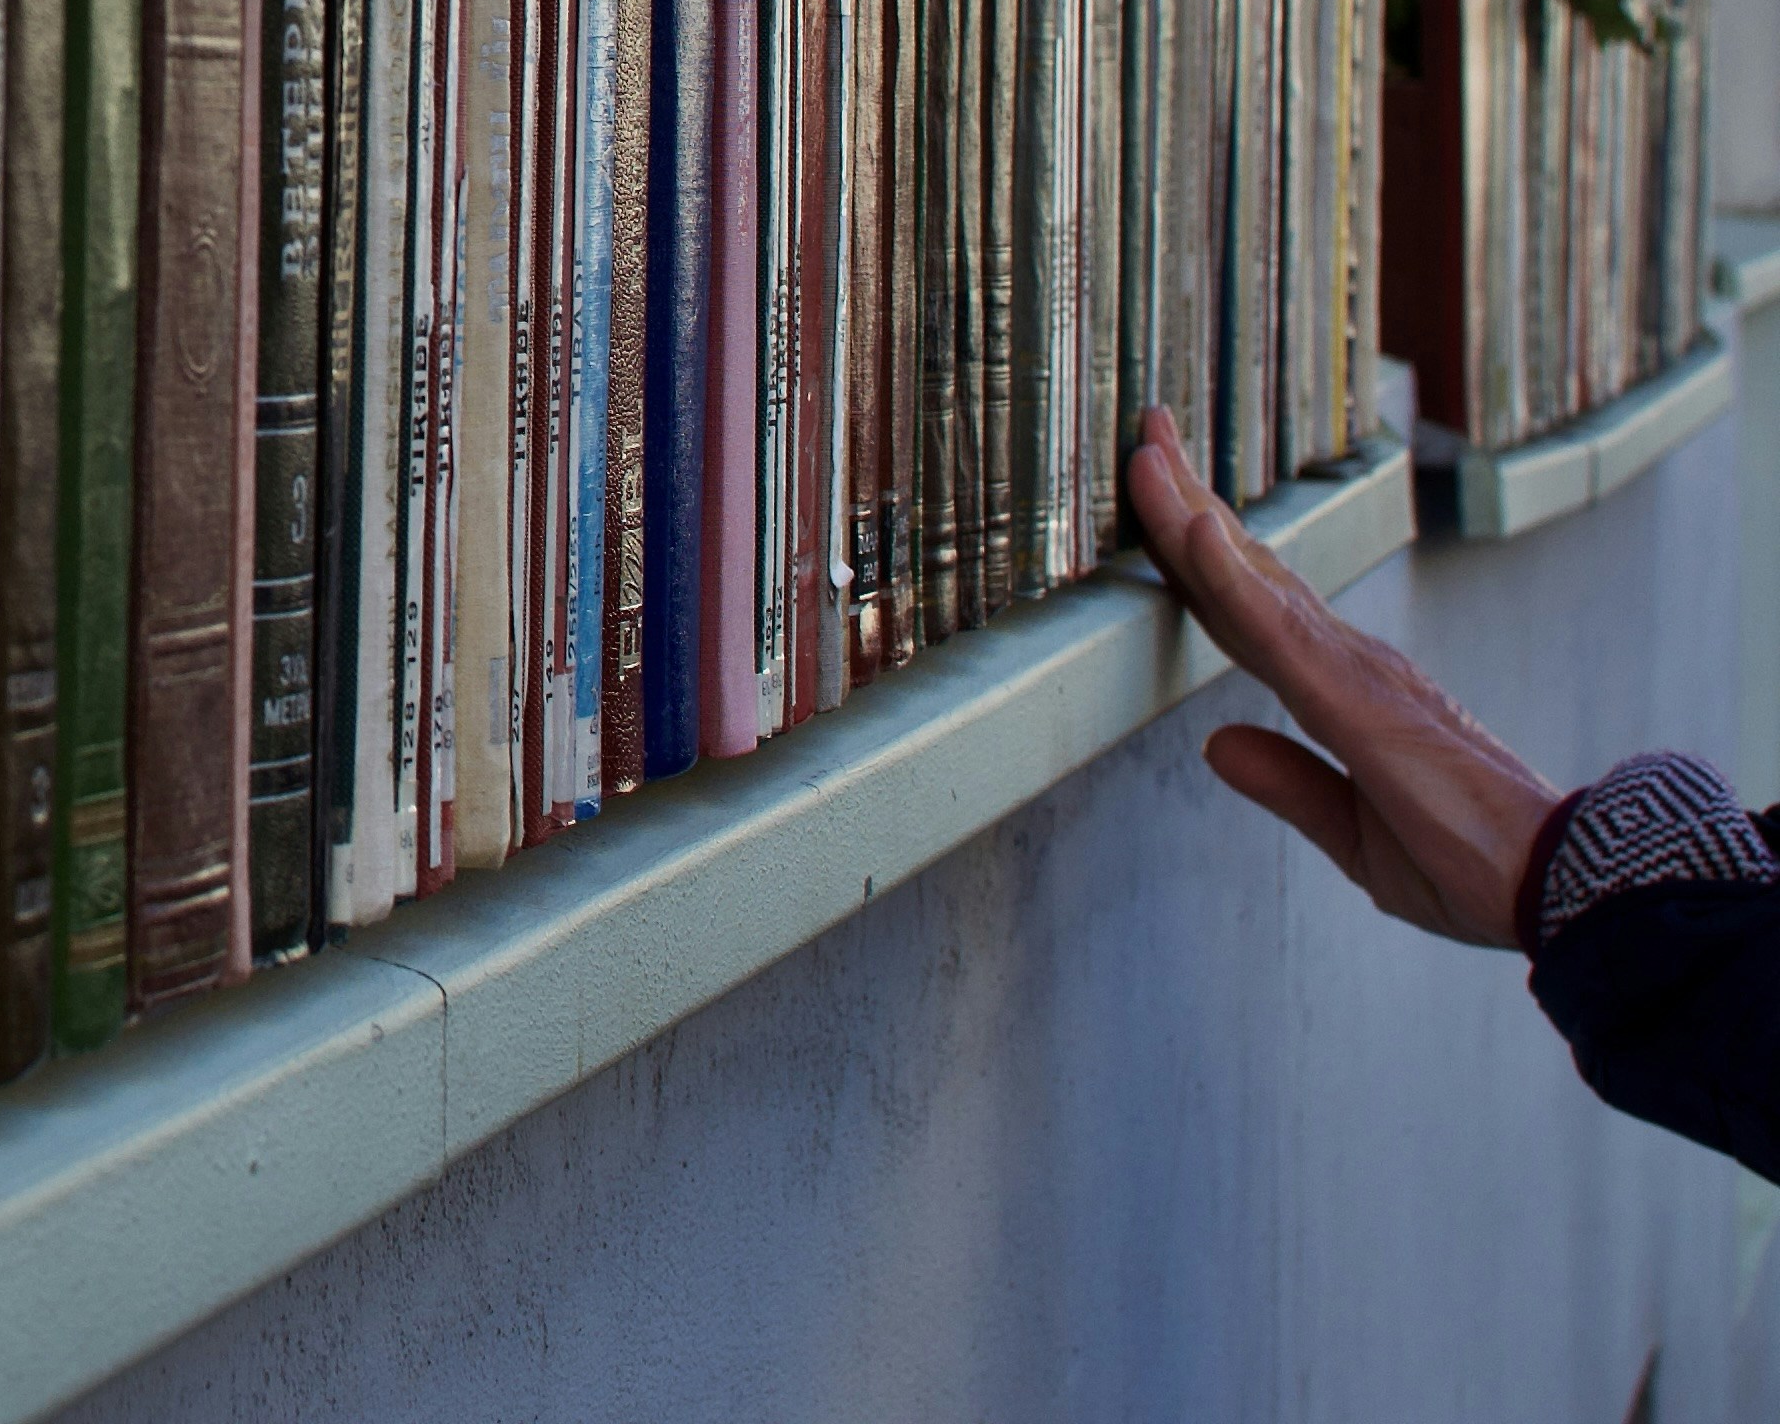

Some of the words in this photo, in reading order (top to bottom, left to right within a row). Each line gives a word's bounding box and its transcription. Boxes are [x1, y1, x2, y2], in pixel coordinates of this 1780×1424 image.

[410, 313, 430, 497] TIRADE
[513, 298, 530, 472] TIRADE
[549, 287, 564, 455] TIRADE
[570, 247, 584, 407] TIRADE
[402, 600, 419, 771] 128-129
